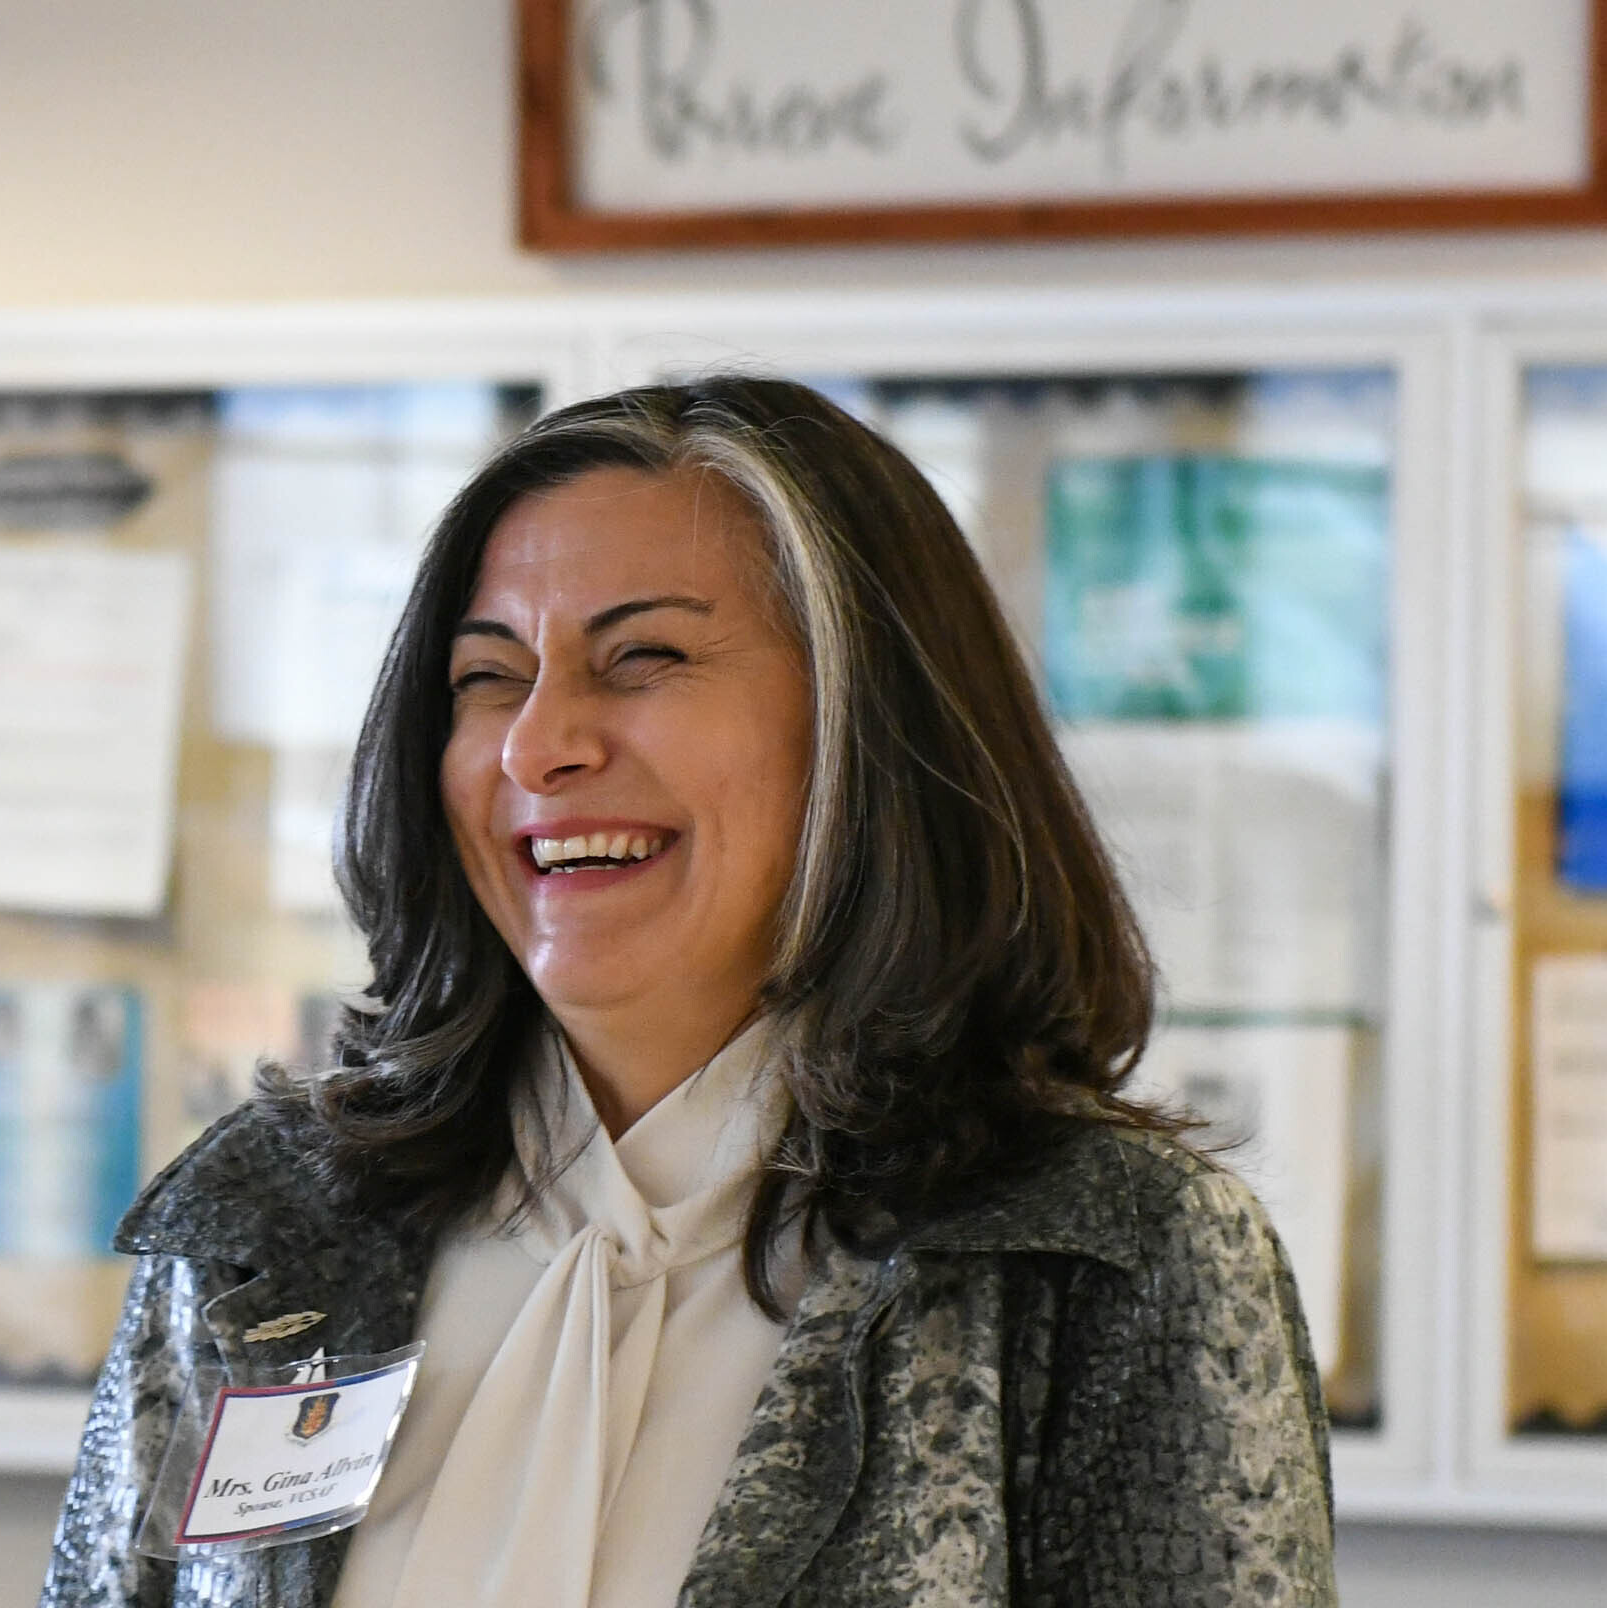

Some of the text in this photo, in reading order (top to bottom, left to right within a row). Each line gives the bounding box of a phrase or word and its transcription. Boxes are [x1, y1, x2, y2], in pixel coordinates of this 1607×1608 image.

[203, 1453, 374, 1498] Mrs. Gina Allvin
